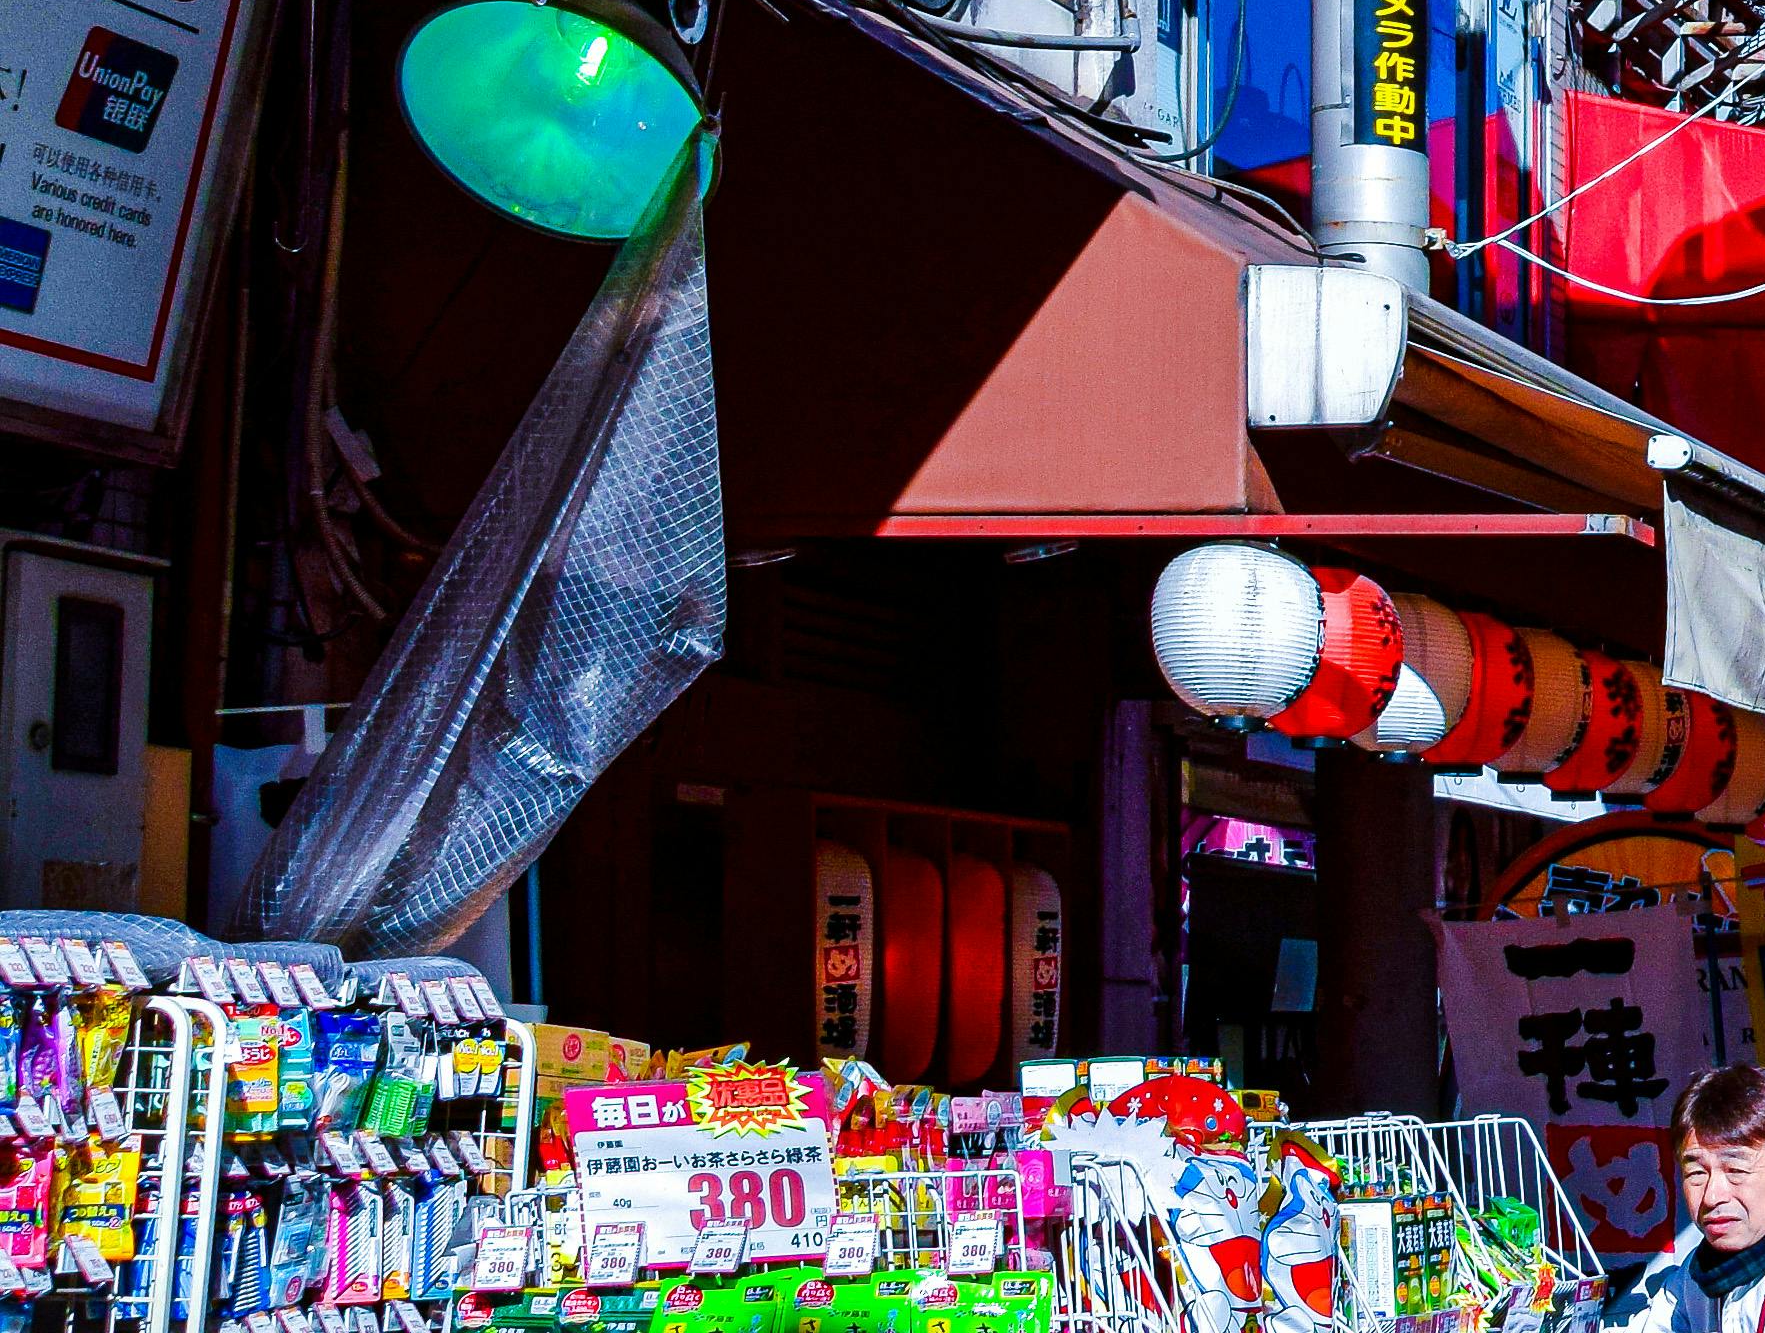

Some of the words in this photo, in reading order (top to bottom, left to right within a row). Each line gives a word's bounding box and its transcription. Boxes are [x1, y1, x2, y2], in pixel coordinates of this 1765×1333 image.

[78, 50, 165, 115] UnionPay
[30, 170, 78, 204] Various
[81, 189, 117, 218] credit
[118, 201, 153, 228] cards
[31, 201, 54, 224] are
[57, 206, 106, 239] honored
[108, 222, 138, 249] here.
[591, 1094, 687, 1129] 毎日が
[586, 1145, 823, 1176] 伊藤園おーいお茶さらさら緑茶
[612, 1197, 633, 1209] 40g
[687, 1167, 806, 1232] 380
[816, 1214, 828, 1228] 円
[790, 1232, 823, 1249] 410
[706, 1247, 732, 1259] 380
[838, 1246, 865, 1260] 380
[962, 1243, 988, 1258] 380
[488, 1260, 516, 1276] 380
[601, 1256, 627, 1270] 380
